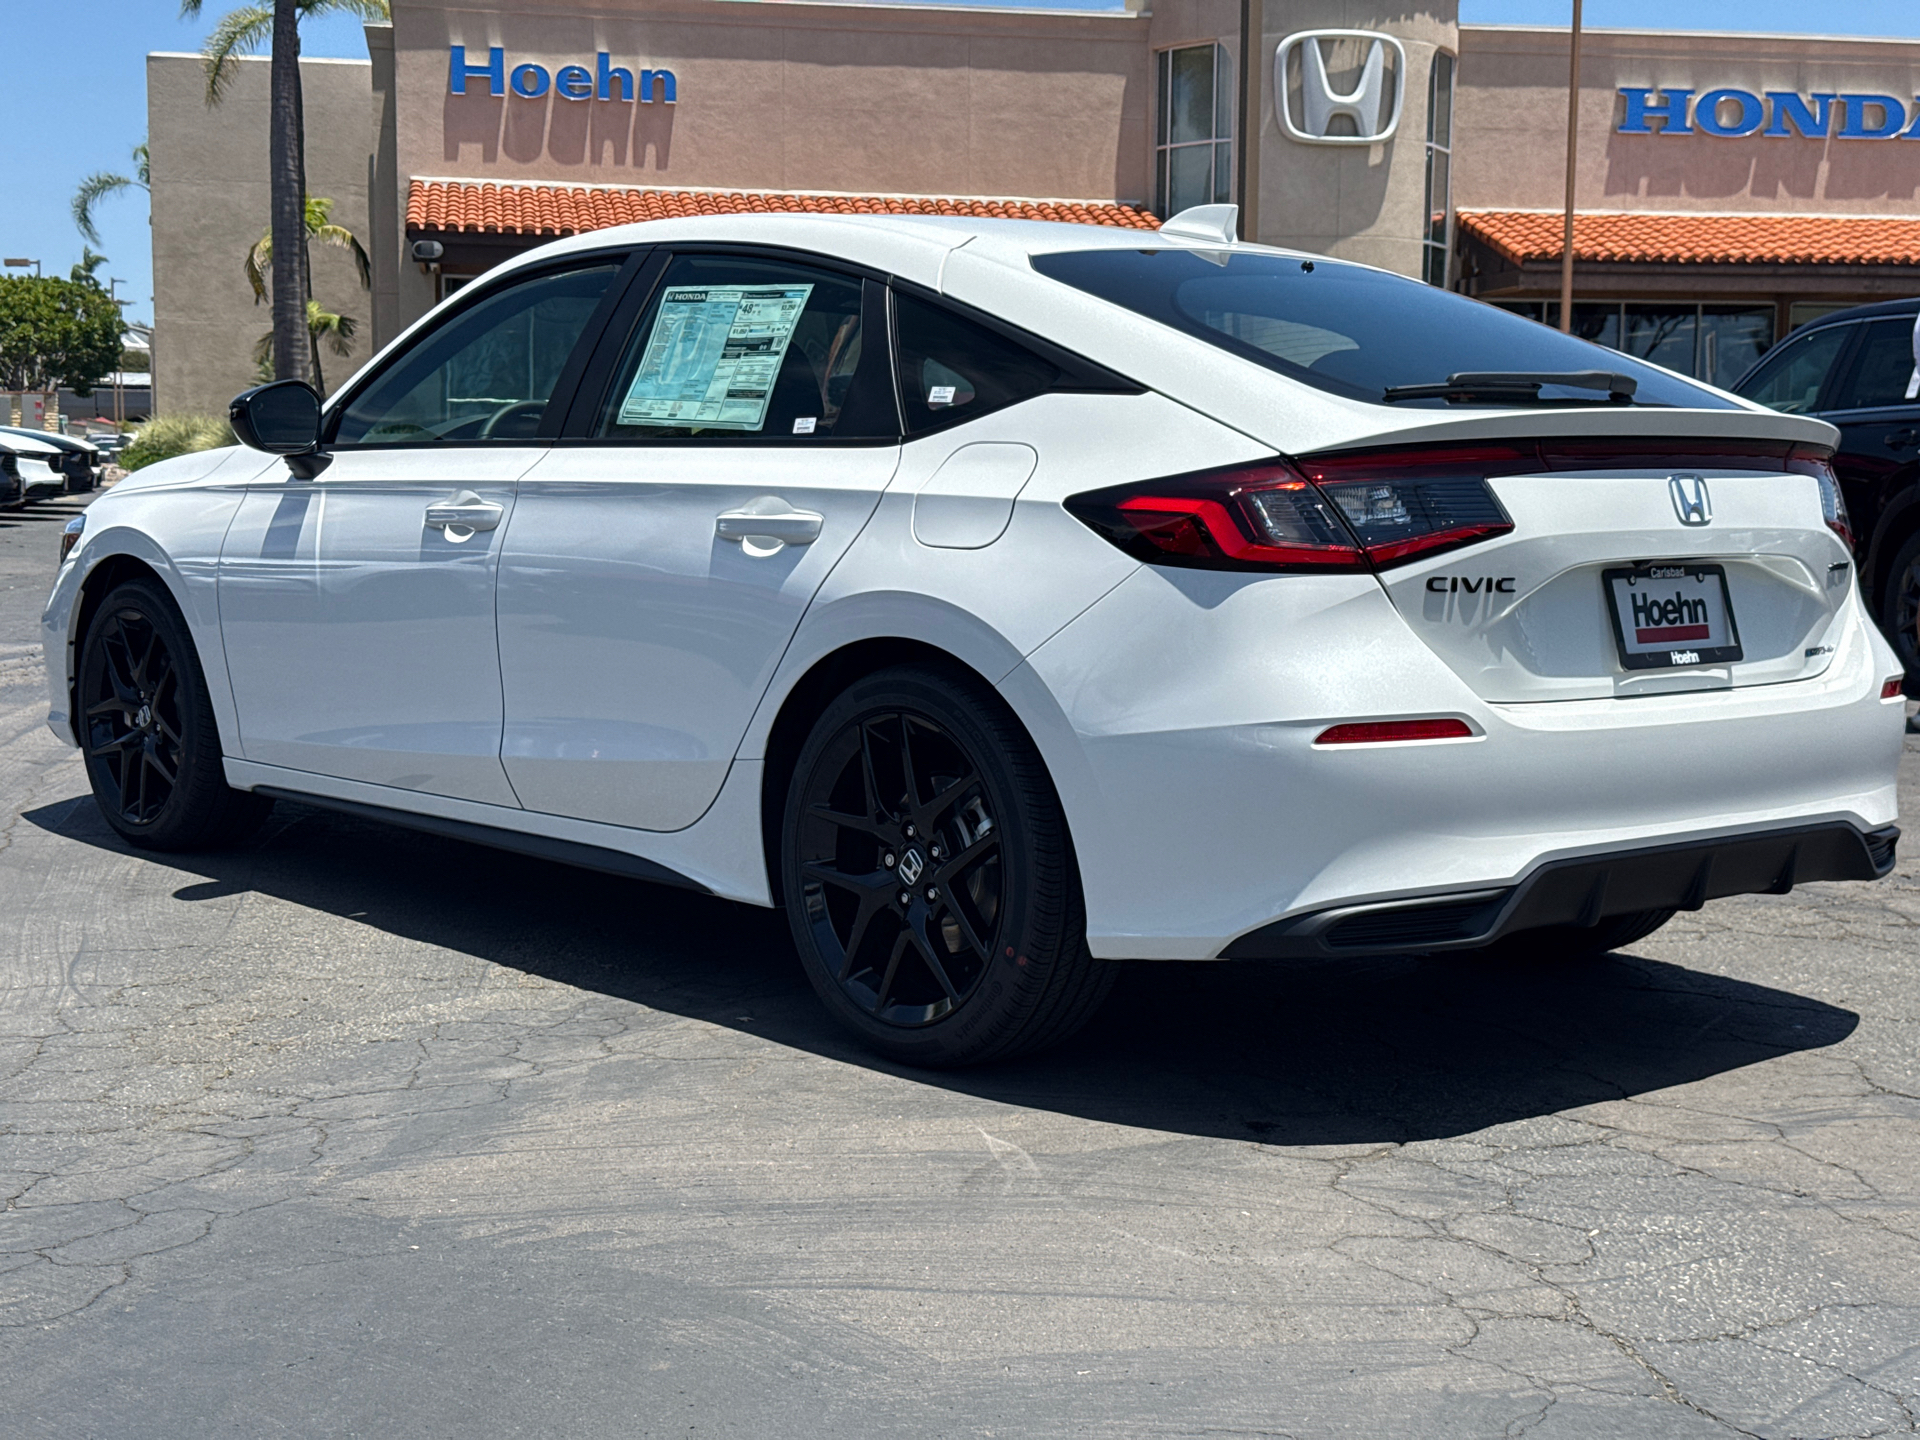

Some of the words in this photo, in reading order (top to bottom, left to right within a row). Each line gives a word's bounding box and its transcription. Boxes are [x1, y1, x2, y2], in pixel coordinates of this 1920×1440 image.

[451, 45, 677, 104] Hoehn
[1618, 88, 1920, 140] HOND
[742, 303, 754, 314] 48
[1650, 567, 1685, 578] Carlsbad
[1426, 577, 1516, 593] CIVIC
[1631, 591, 1708, 627] Hoehn
[1670, 651, 1700, 664] Hoehn
